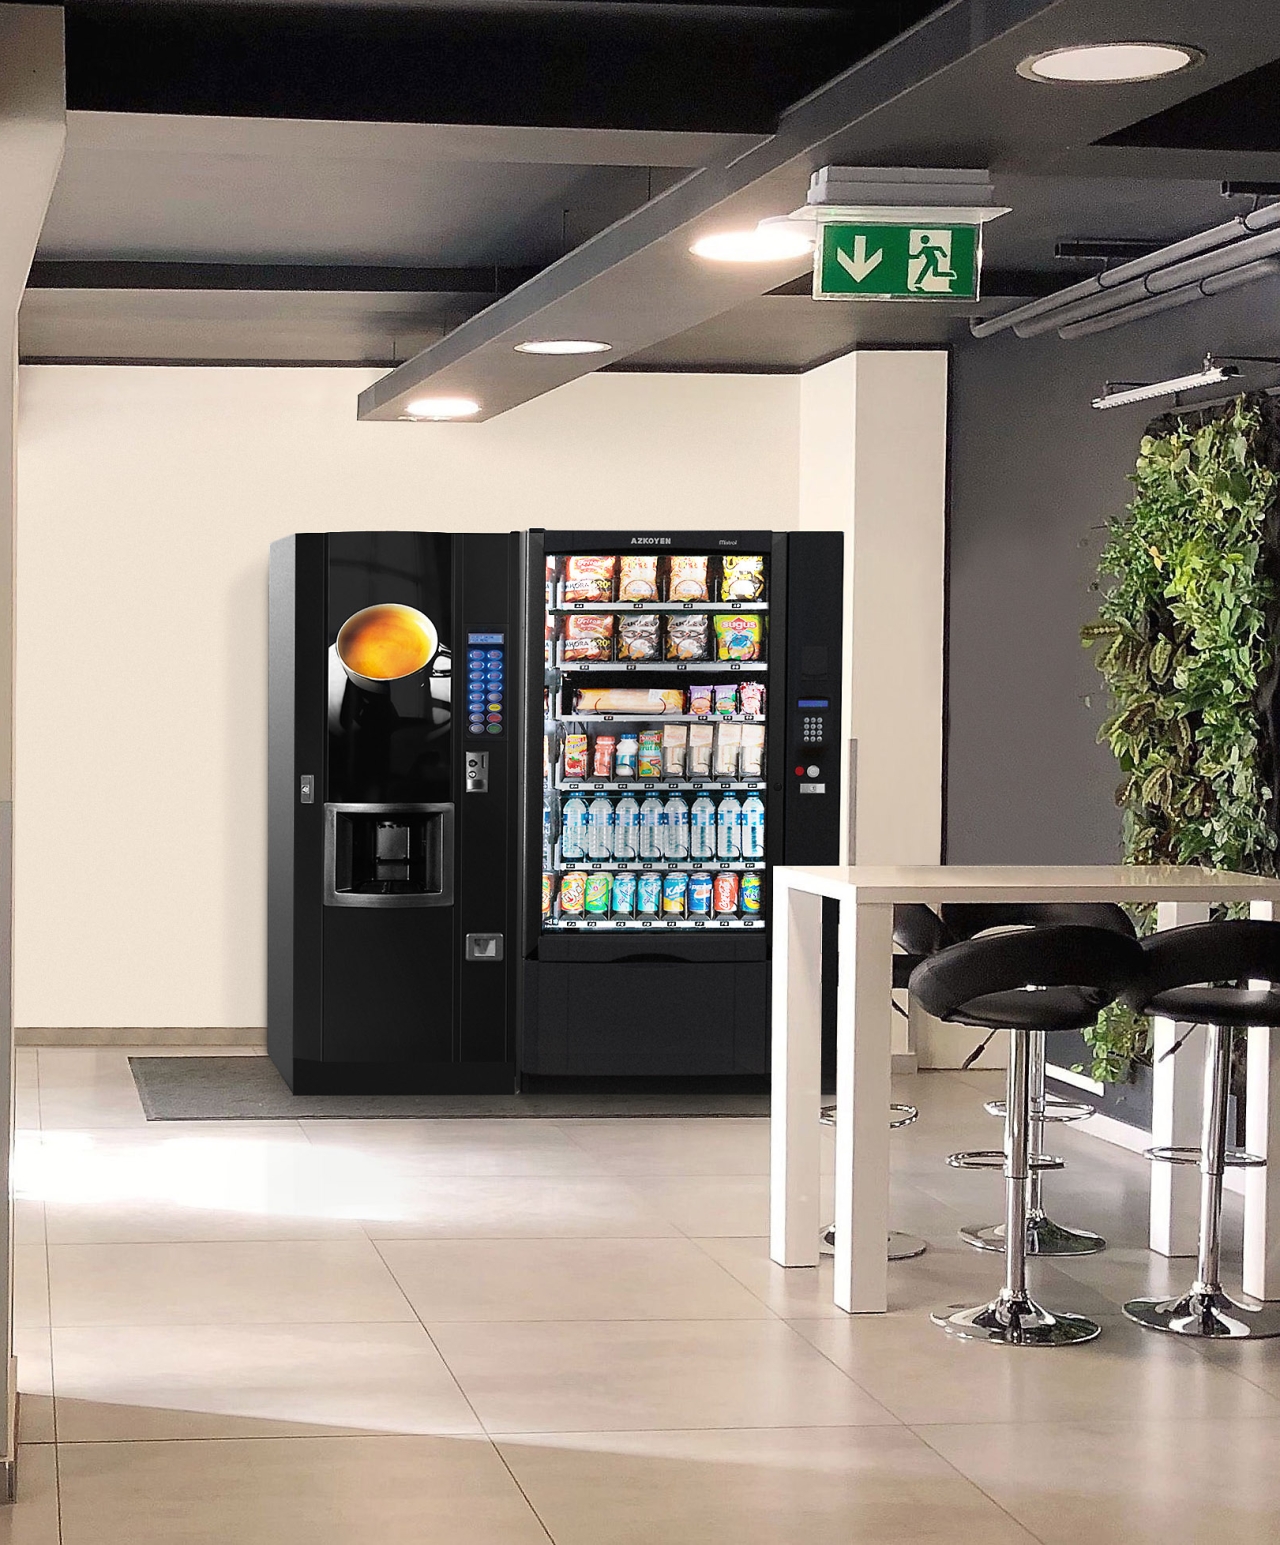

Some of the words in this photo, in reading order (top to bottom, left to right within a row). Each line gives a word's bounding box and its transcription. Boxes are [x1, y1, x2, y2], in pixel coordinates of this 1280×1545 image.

[631, 537, 672, 545] AZKOYEN
[721, 620, 757, 630] sugus
[665, 883, 687, 897] KAS
